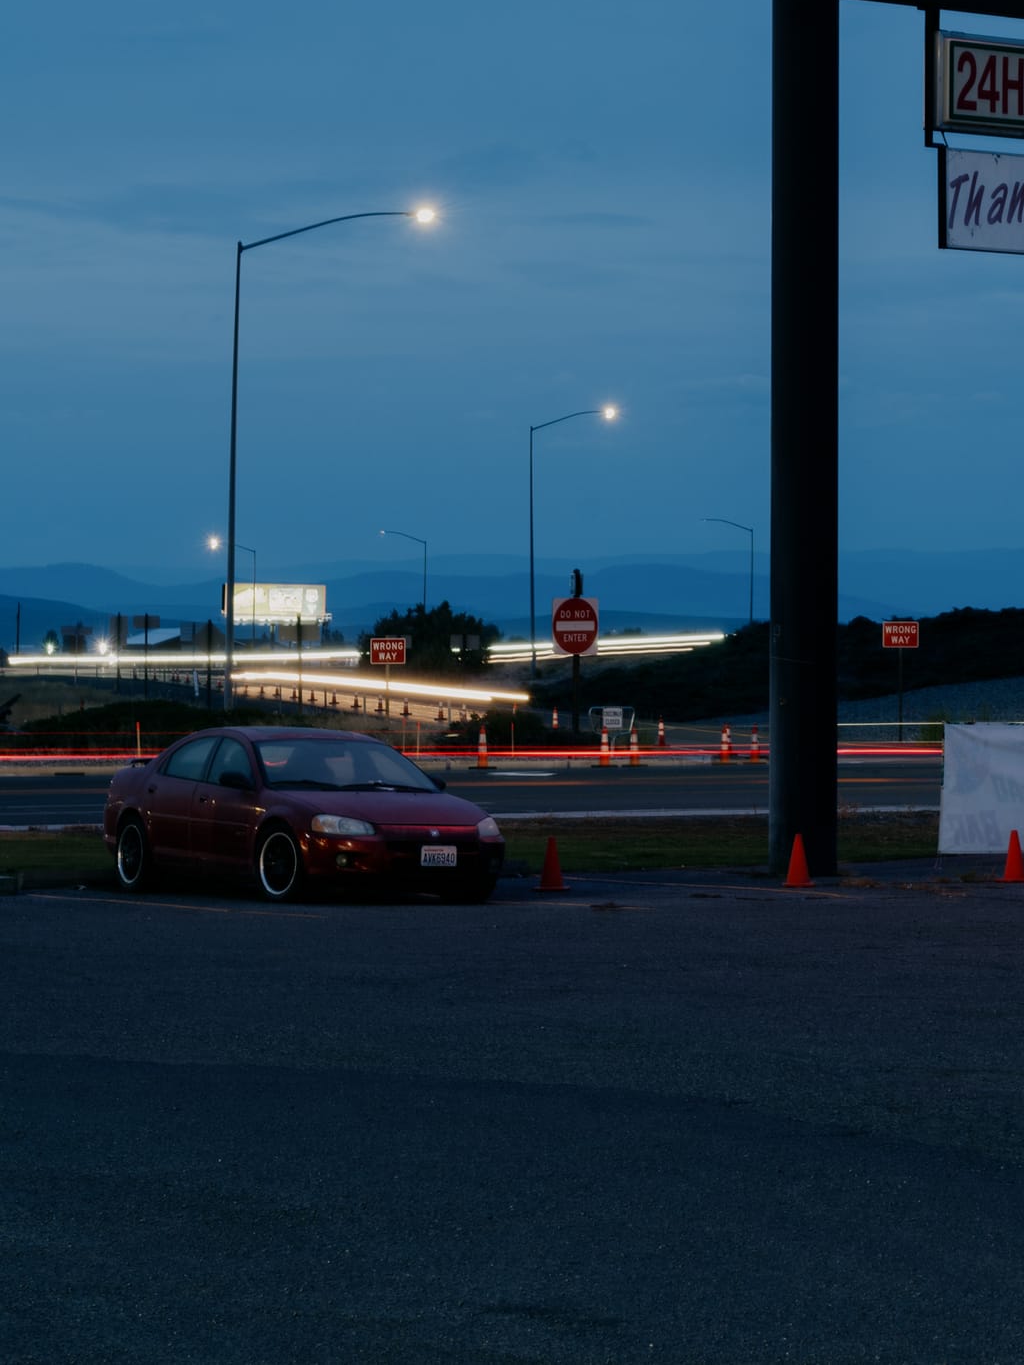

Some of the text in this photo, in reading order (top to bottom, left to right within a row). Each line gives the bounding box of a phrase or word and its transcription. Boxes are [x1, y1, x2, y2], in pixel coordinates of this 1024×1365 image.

[560, 610, 590, 619] DO NOT
[885, 625, 917, 635] WRONG
[563, 633, 587, 643] ENTER
[891, 635, 910, 645] WAY
[372, 642, 403, 651] WRONG
[378, 652, 397, 661] WAY
